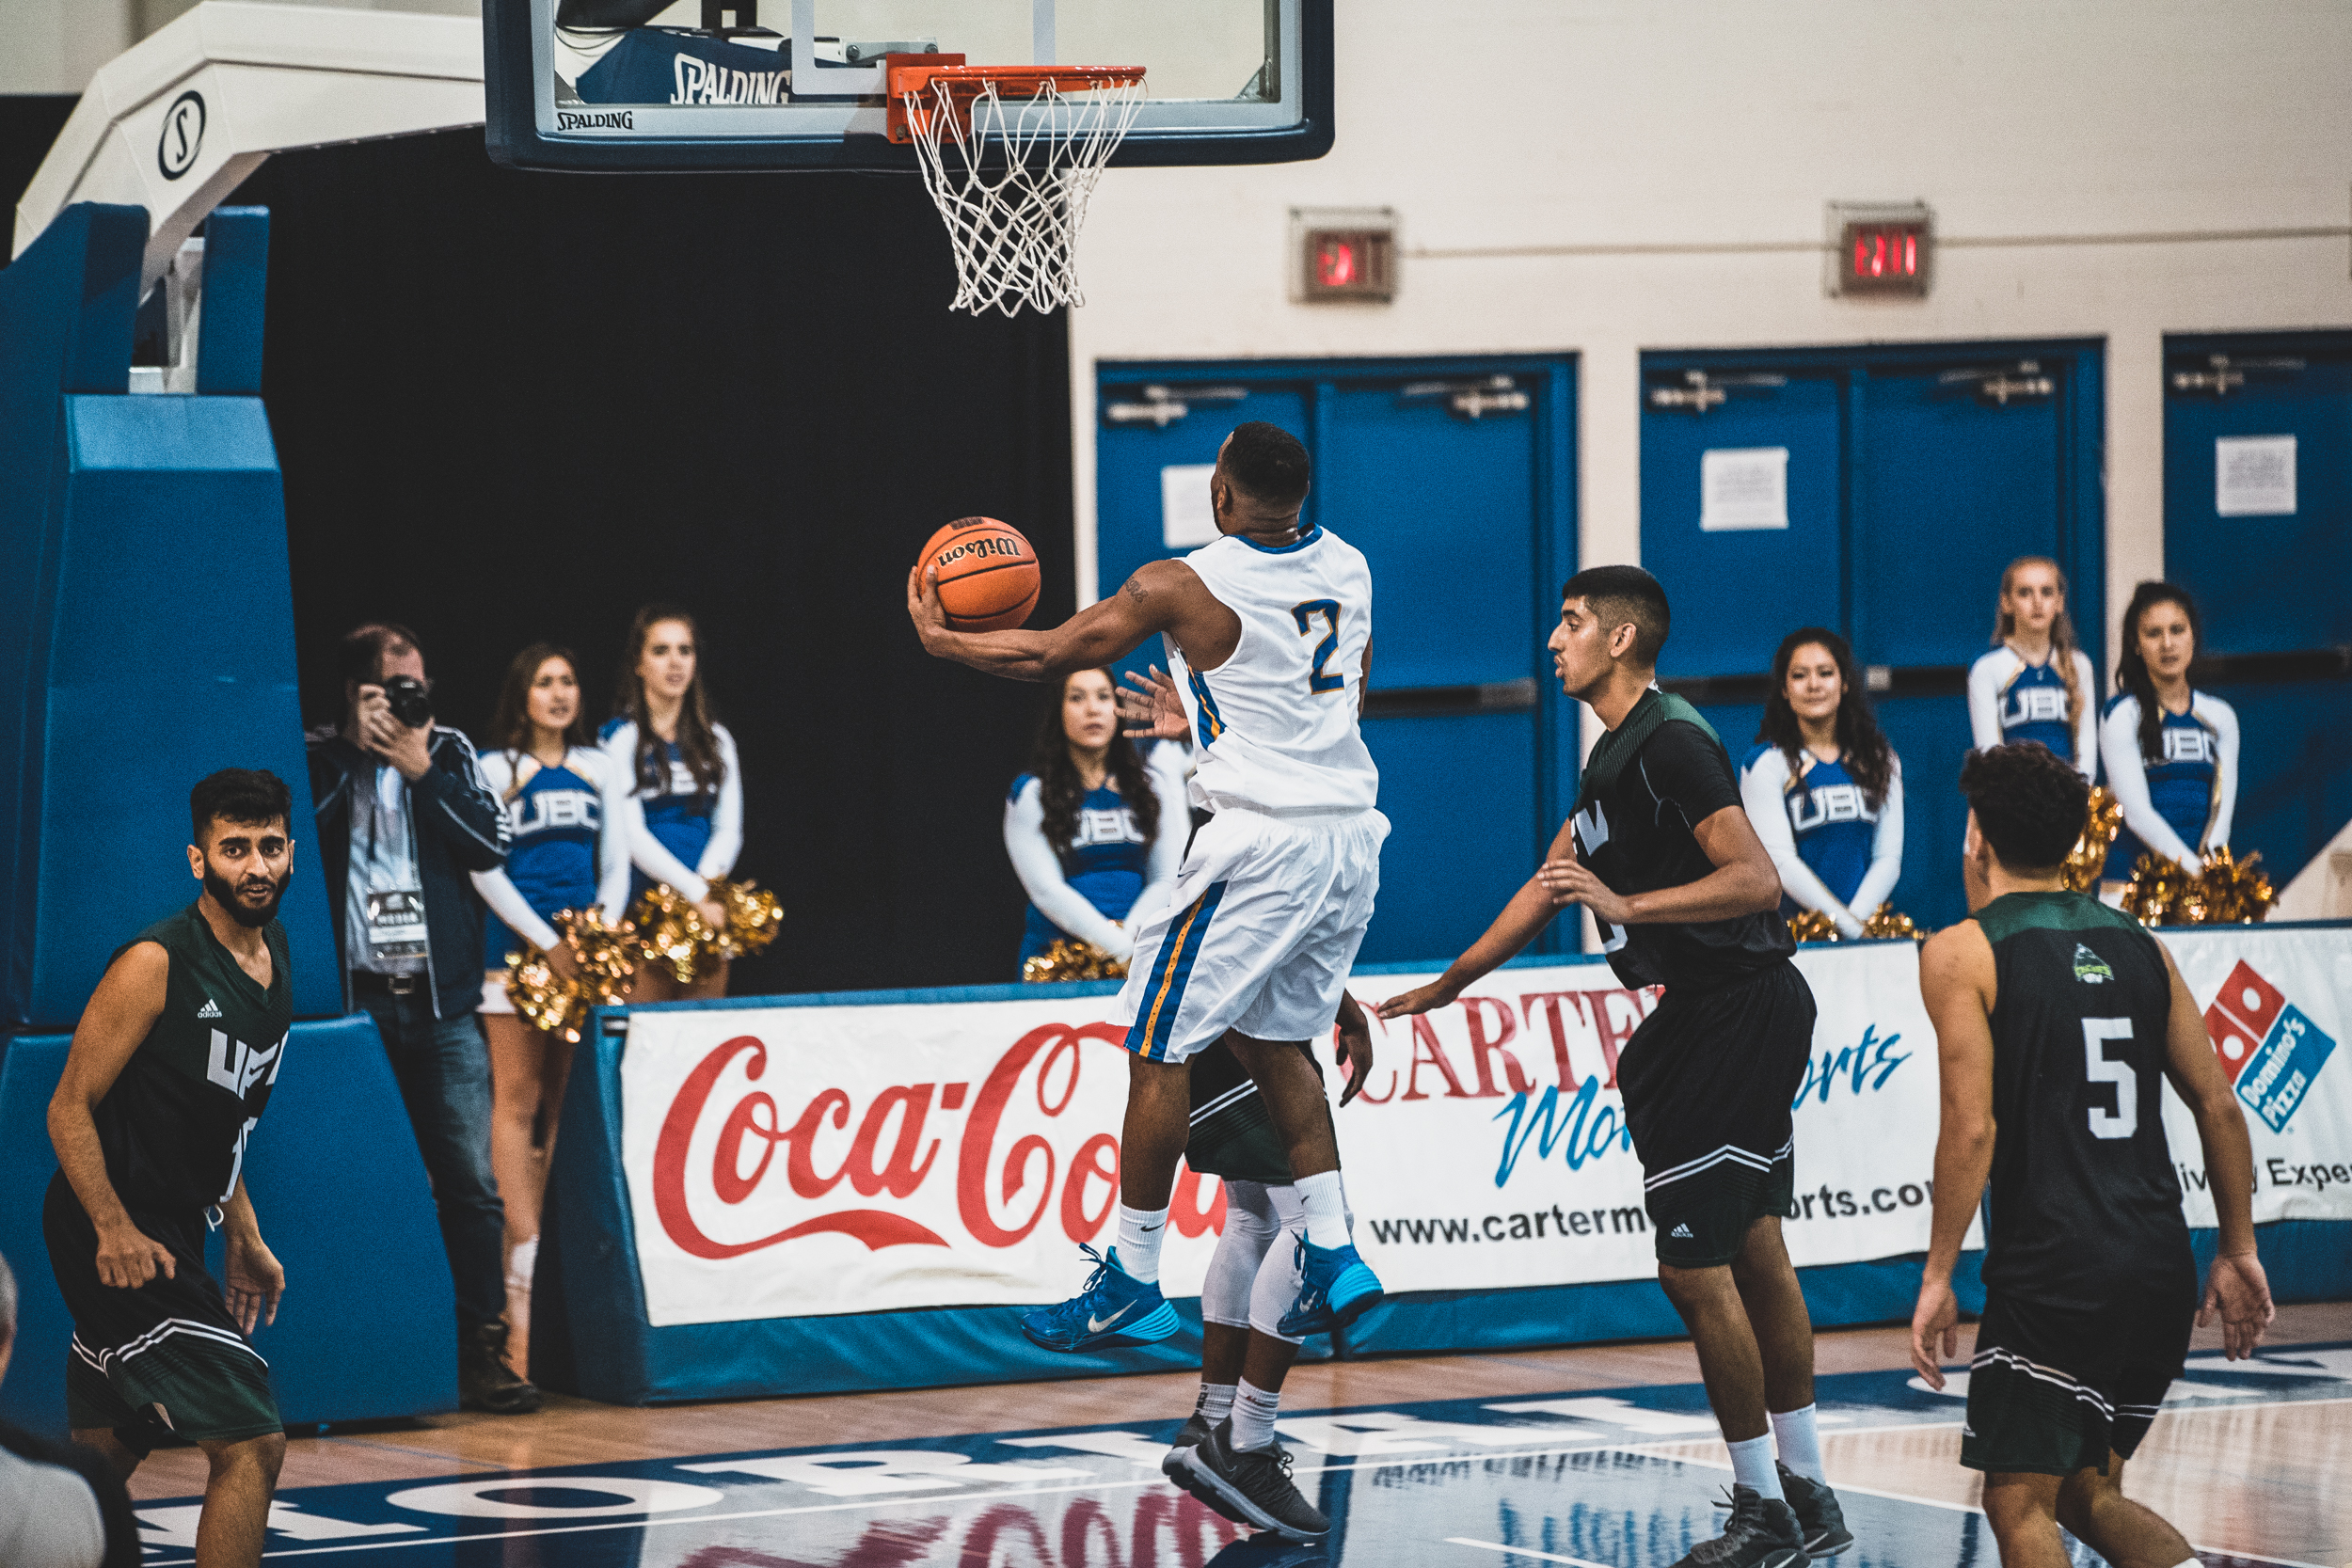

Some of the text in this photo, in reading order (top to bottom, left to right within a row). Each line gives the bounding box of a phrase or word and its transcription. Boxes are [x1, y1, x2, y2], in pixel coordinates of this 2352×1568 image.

[670, 52, 792, 105] SPALDING
[557, 110, 633, 132] SPALDING
[937, 537, 1021, 567] Wilson
[1291, 598, 1345, 696] 2
[509, 790, 600, 836] UBC
[198, 1010, 223, 1019] adidas
[1333, 984, 1666, 1105] CARTE
[2240, 1017, 2306, 1108] Domino's
[2081, 1017, 2137, 1140] 5
[2261, 1068, 2307, 1128] Pizza
[653, 1022, 1228, 1259] Coca-Coa
[2266, 1157, 2352, 1192] Expe
